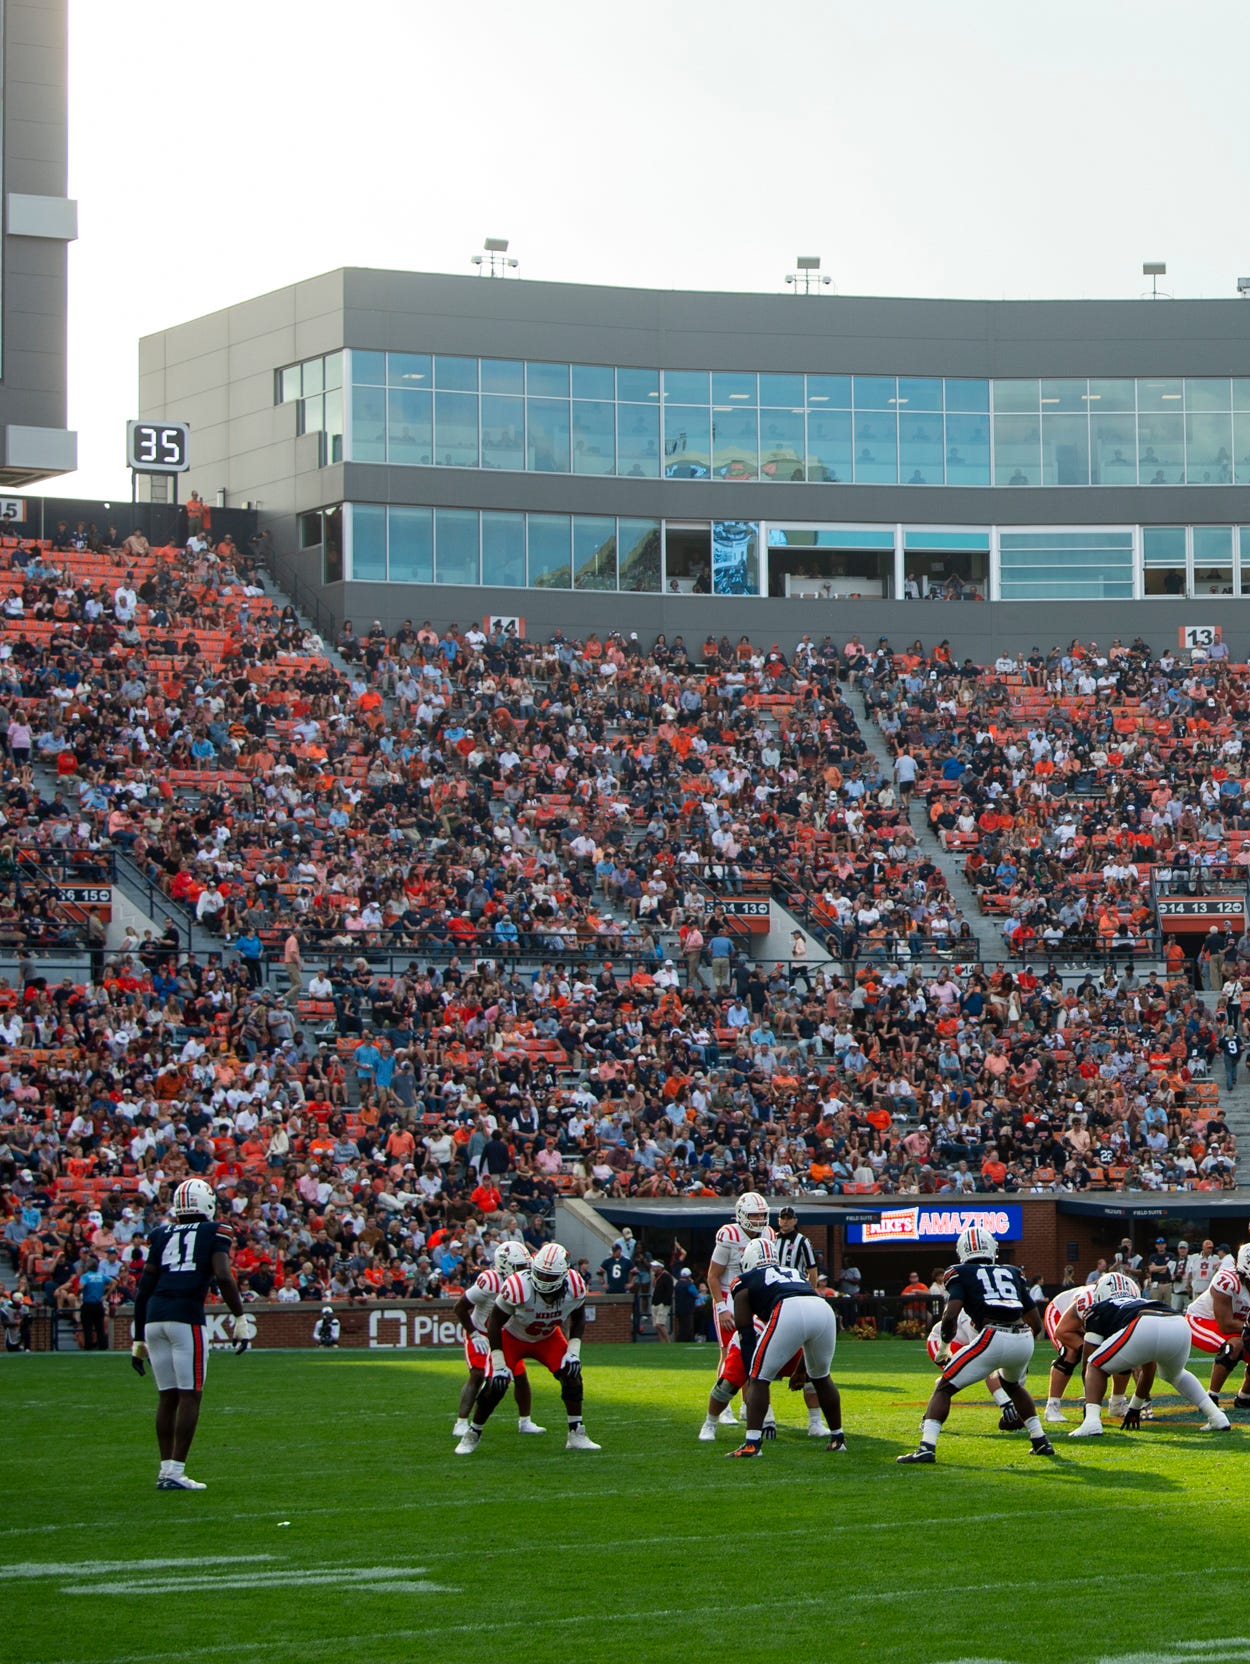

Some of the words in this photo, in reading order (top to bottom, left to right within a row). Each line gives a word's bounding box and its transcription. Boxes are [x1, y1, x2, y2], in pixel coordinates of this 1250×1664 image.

[140, 428, 180, 463] 35
[1187, 629, 1214, 646] 13
[82, 890, 98, 901] 15
[742, 903, 757, 914] 13
[1169, 903, 1184, 913] 14
[1192, 903, 1207, 913] 13
[1216, 902, 1232, 913] 12
[1227, 1040, 1237, 1054] 9
[918, 1212, 1010, 1235] AMAZING
[161, 1230, 197, 1272] 41
[612, 1263, 621, 1279] 6
[976, 1267, 1019, 1300] 16
